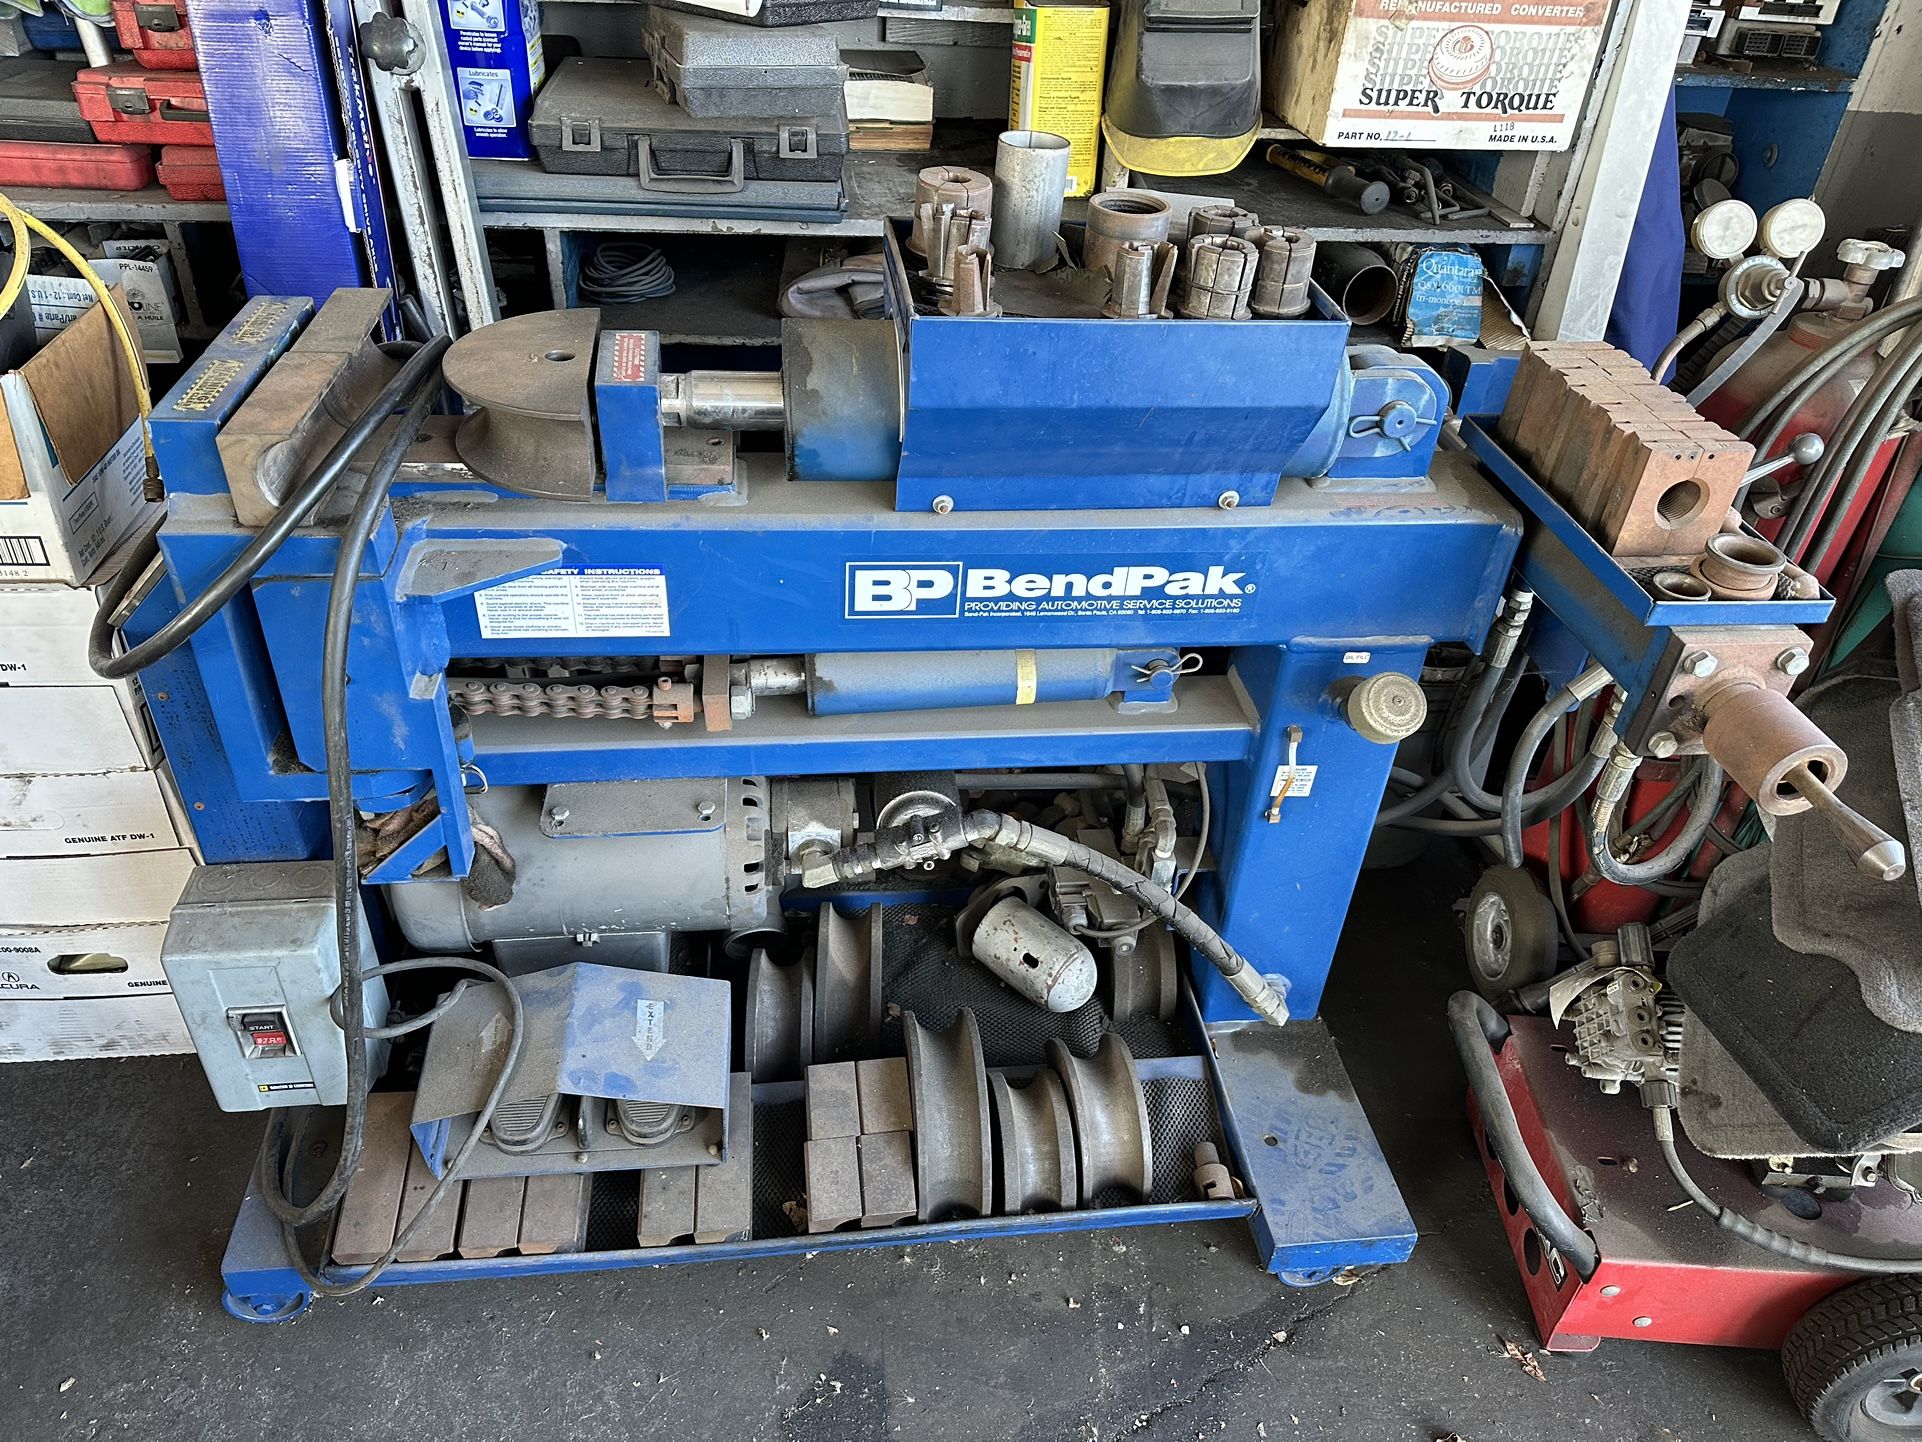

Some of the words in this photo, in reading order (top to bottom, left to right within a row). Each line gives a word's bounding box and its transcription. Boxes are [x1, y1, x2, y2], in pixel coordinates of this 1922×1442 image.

[1511, 4, 1584, 18] CONVERTER
[1359, 86, 1442, 116] SUPER
[1460, 90, 1559, 117] TORQUE
[334, 36, 353, 120] CONSTANT
[349, 120, 365, 190] VELOCITY
[1337, 131, 1358, 140] PART
[1365, 132, 1383, 142] NO.
[1488, 134, 1516, 144] MADE
[1518, 135, 1528, 143] IN
[1531, 135, 1558, 144] U.S.A.
[119, 263, 153, 273] PPL-14459
[54, 291, 62, 301] 12
[83, 294, 94, 303] Net
[45, 312, 78, 324] art/Parte
[854, 569, 955, 612] BP
[964, 601, 1037, 611] PROVIDING
[1038, 600, 1121, 610] AUTOMOTIVE
[1122, 599, 1174, 609] SERVICE
[1174, 598, 1243, 609] SOLUTIONS
[0, 664, 27, 672] DW-1
[64, 835, 108, 844] GENUINE
[110, 834, 128, 842] ATF
[129, 832, 155, 841] DW-1
[127, 979, 169, 988] GENUINE
[645, 1002, 655, 1051] EXTEND
